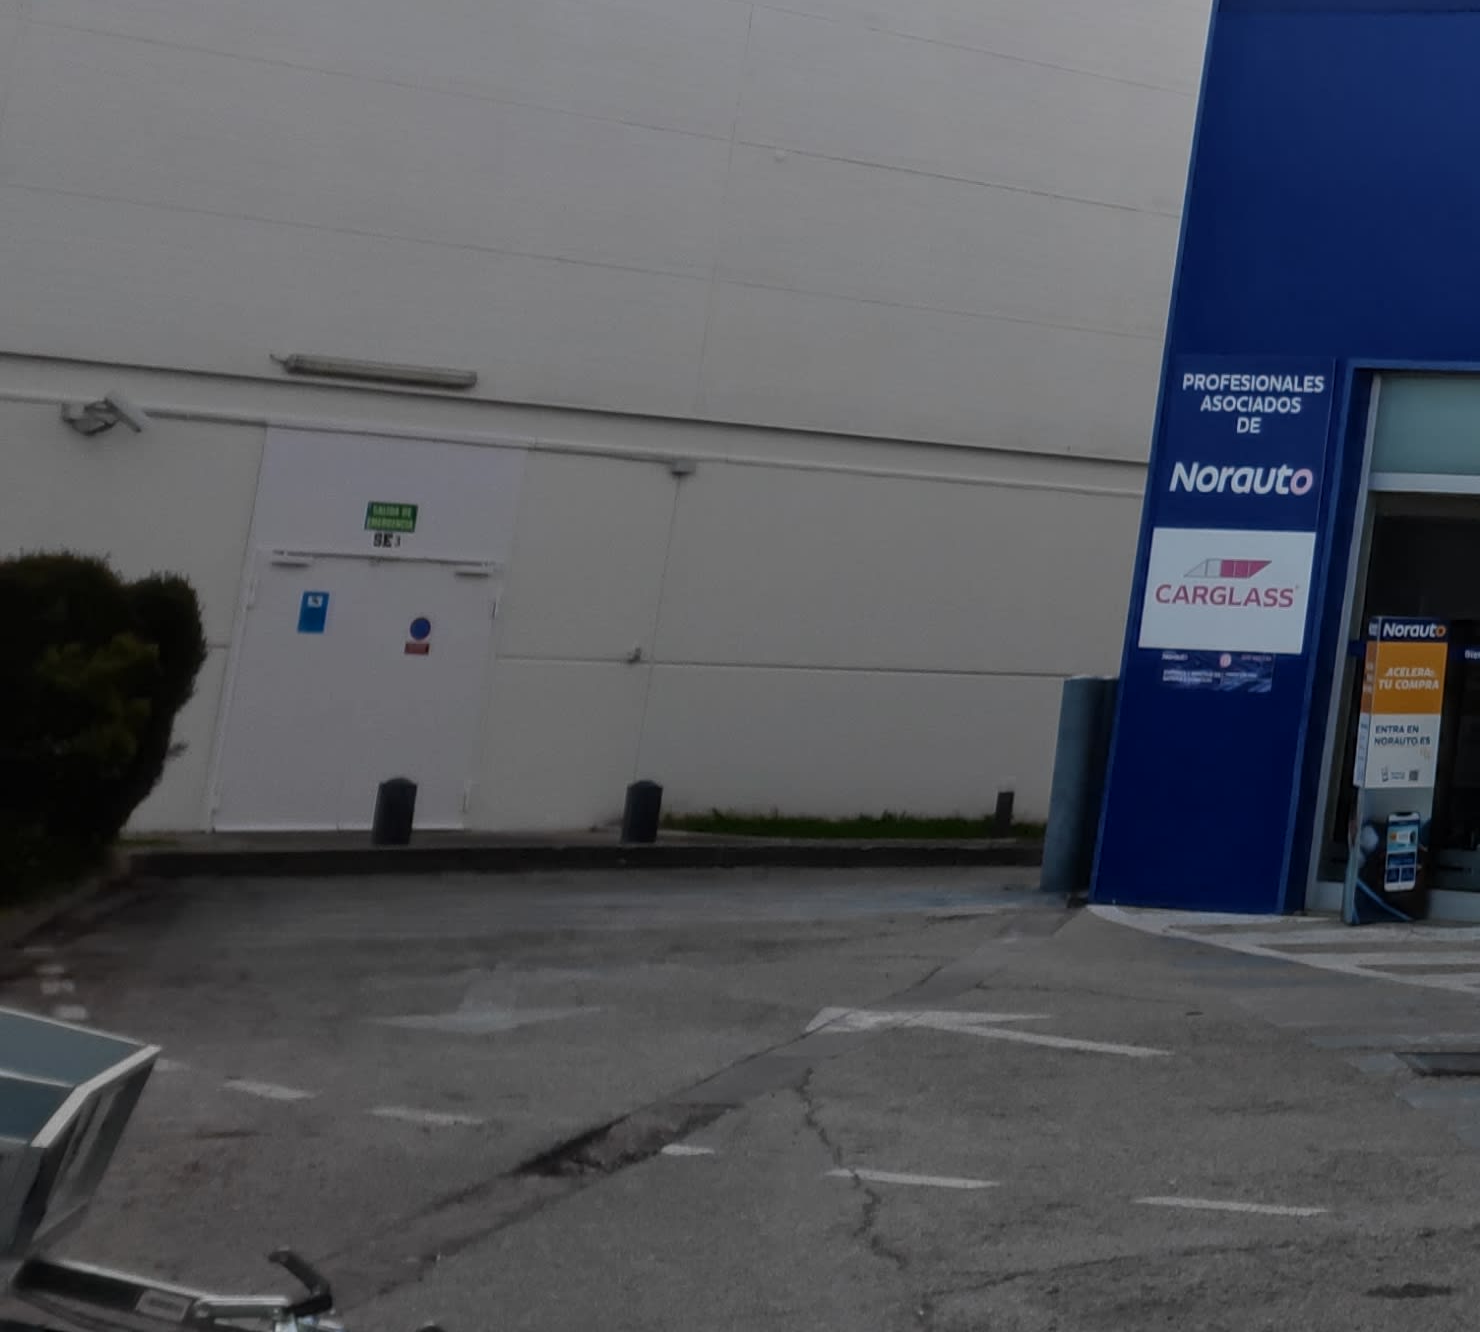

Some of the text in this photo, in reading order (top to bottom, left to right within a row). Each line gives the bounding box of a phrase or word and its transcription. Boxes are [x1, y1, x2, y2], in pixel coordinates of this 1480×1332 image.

[1182, 373, 1325, 393] PROFESIONALES
[1200, 395, 1302, 413] ASOCIADOS
[1236, 417, 1261, 433] DE
[1169, 461, 1313, 496] Norauto
[1155, 584, 1295, 608] CARGLASS
[1383, 622, 1446, 637] Norauto
[1379, 679, 1440, 690] TU COMPRA
[1375, 725, 1420, 734] ENTRA EN
